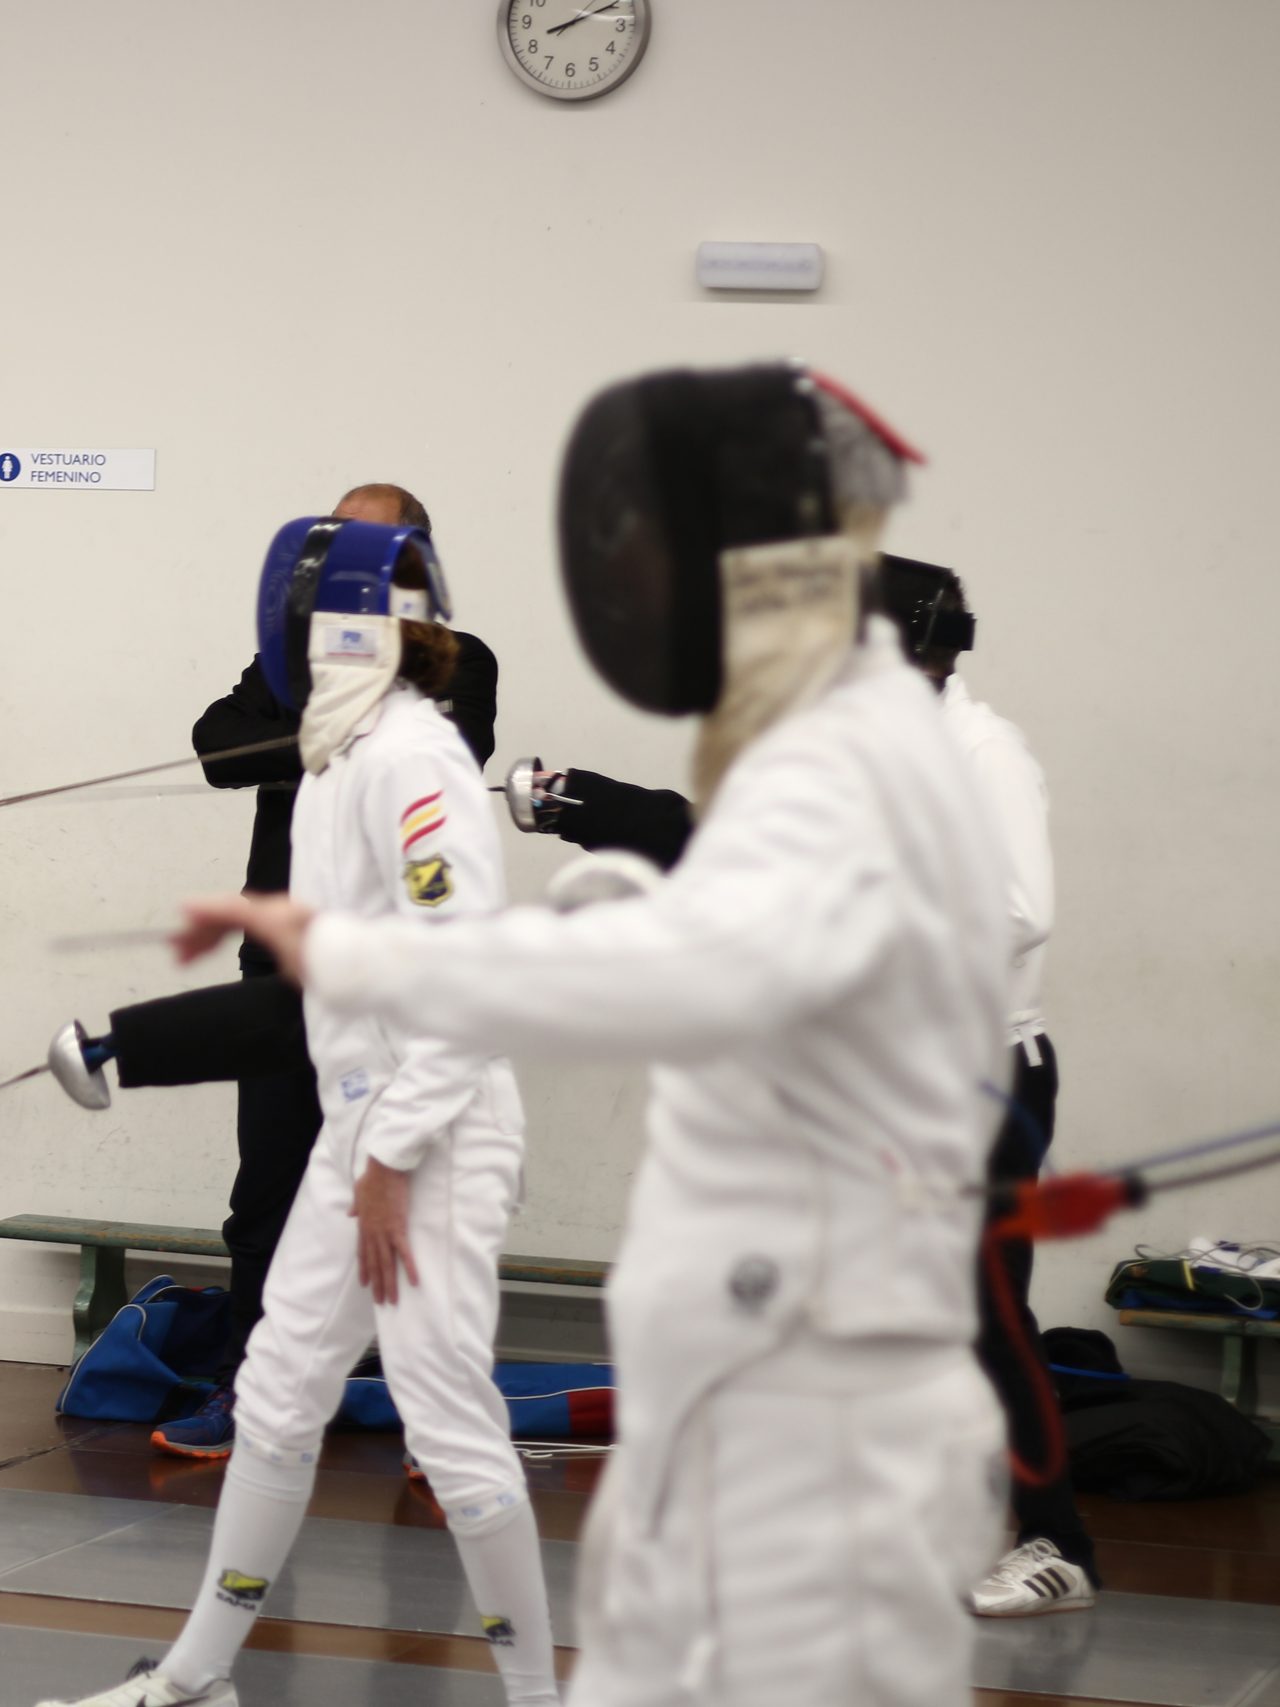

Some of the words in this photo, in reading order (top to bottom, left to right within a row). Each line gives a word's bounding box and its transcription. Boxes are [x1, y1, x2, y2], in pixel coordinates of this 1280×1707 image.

[522, 15, 532, 30] 9
[615, 17, 626, 33] 3
[528, 39, 538, 54] 8
[606, 40, 616, 55] 4
[544, 55, 554, 70] 7
[565, 62, 576, 78] 6
[588, 57, 599, 72] 5
[30, 453, 106, 466] VESTUARIO
[30, 470, 101, 483] FEMENINO
